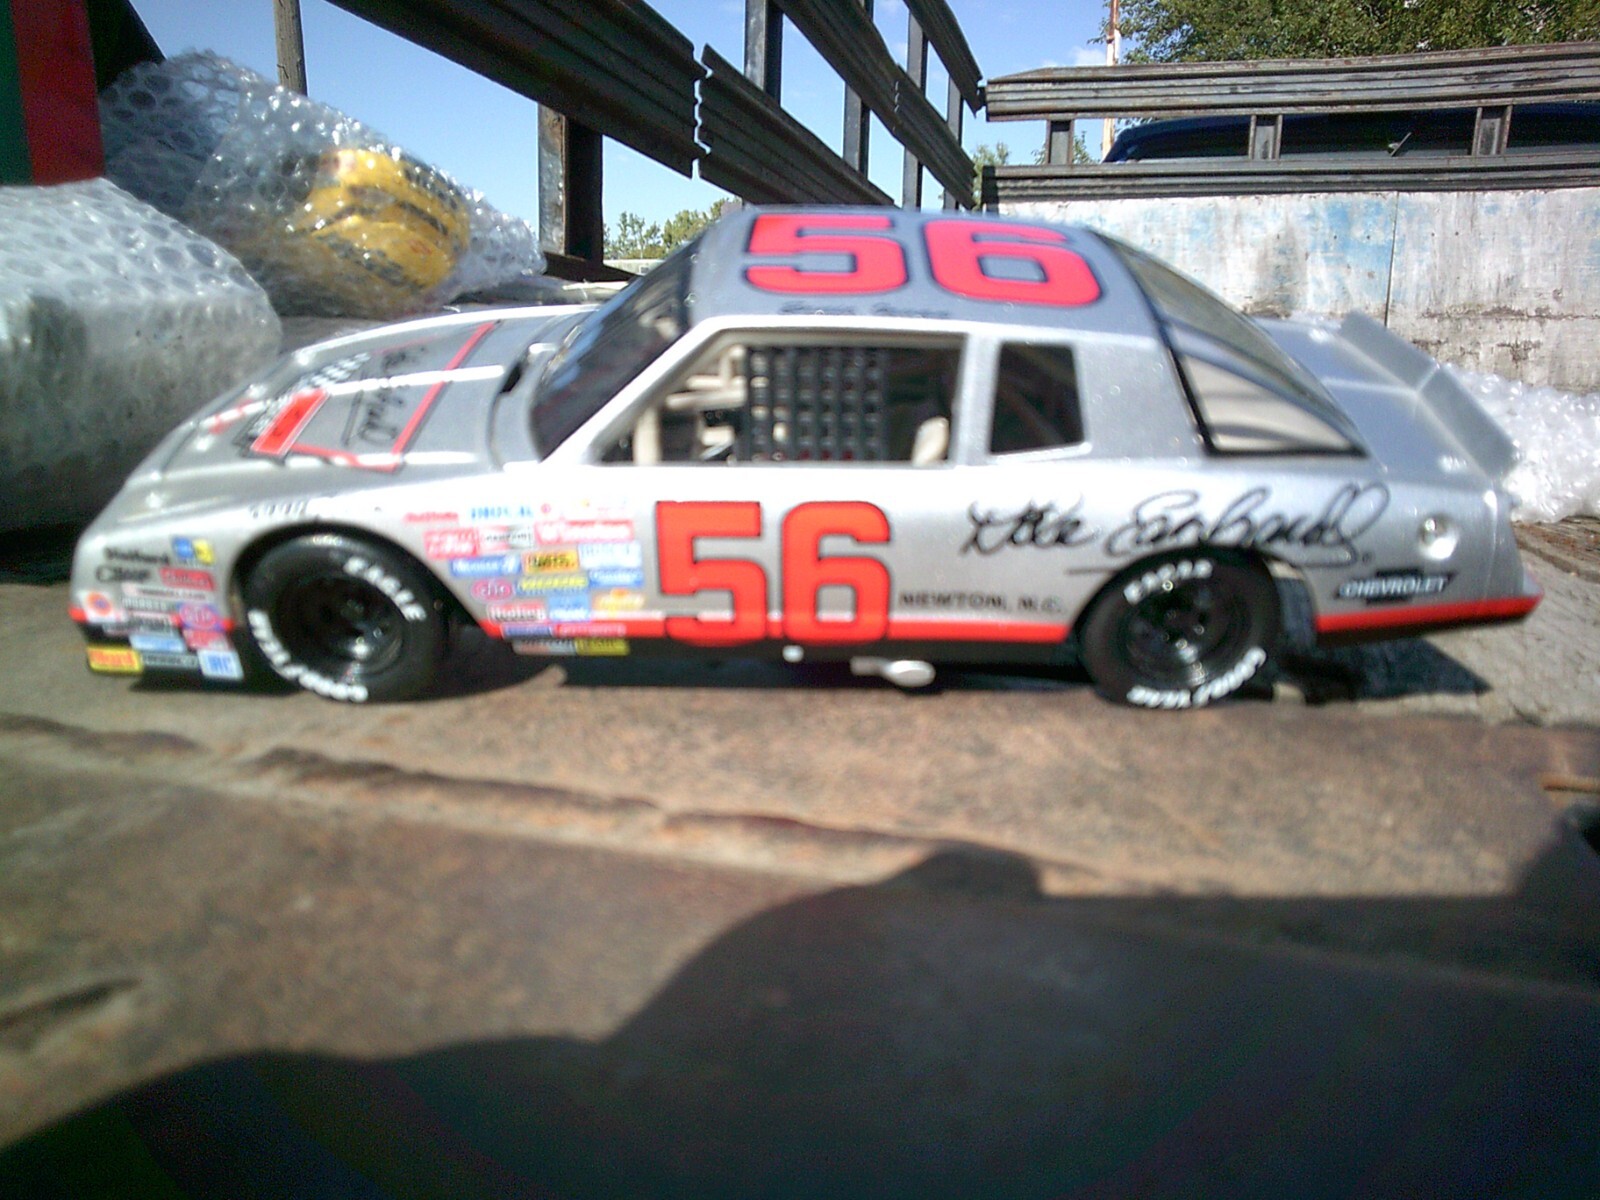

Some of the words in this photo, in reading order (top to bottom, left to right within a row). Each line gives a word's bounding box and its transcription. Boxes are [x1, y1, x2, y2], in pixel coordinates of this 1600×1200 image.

[744, 212, 1103, 308] 56
[655, 500, 891, 647] 56
[1337, 575, 1446, 599] CHEVROLET
